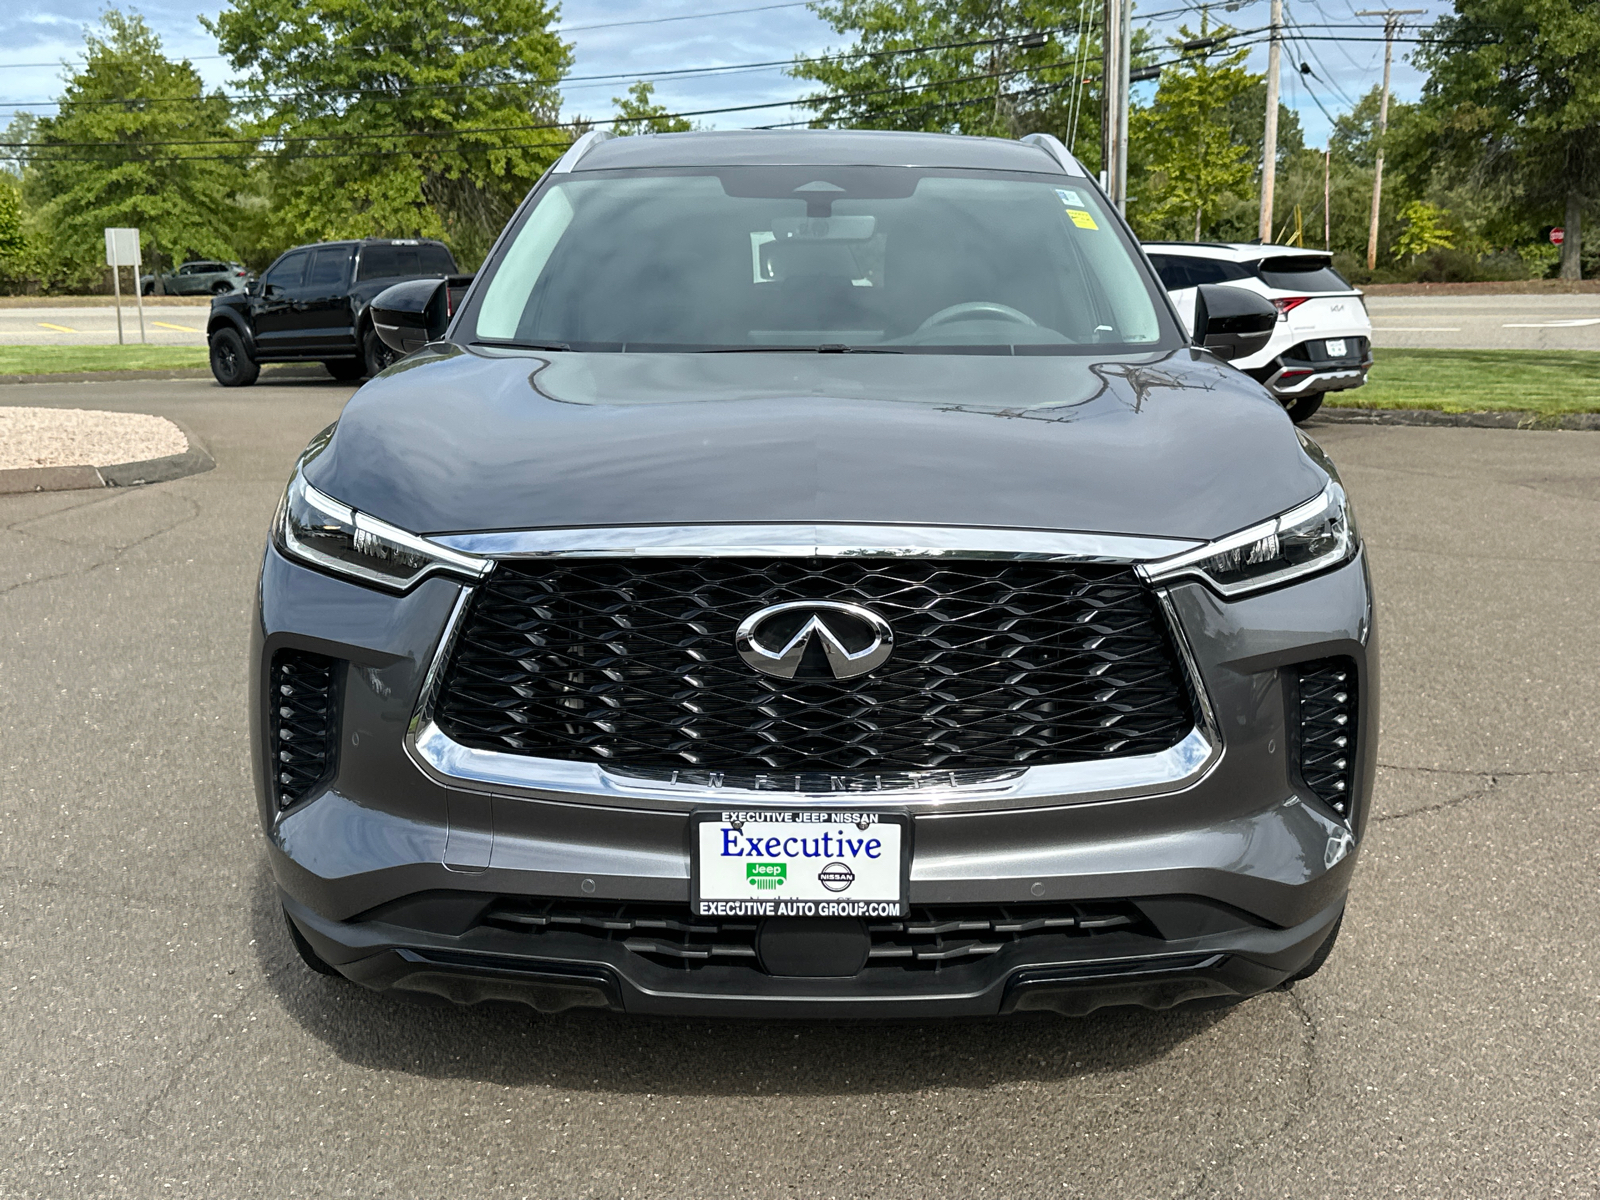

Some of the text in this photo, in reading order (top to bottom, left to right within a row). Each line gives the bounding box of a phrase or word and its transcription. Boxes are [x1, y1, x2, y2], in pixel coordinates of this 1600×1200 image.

[669, 770, 958, 791] INFINITI
[721, 812, 879, 823] EXECUTIVE JEEP NISSAN
[720, 828, 881, 859] Executive
[752, 864, 782, 876] Jeep
[699, 902, 775, 915] EXECUTIVE
[777, 903, 816, 916] AUTO
